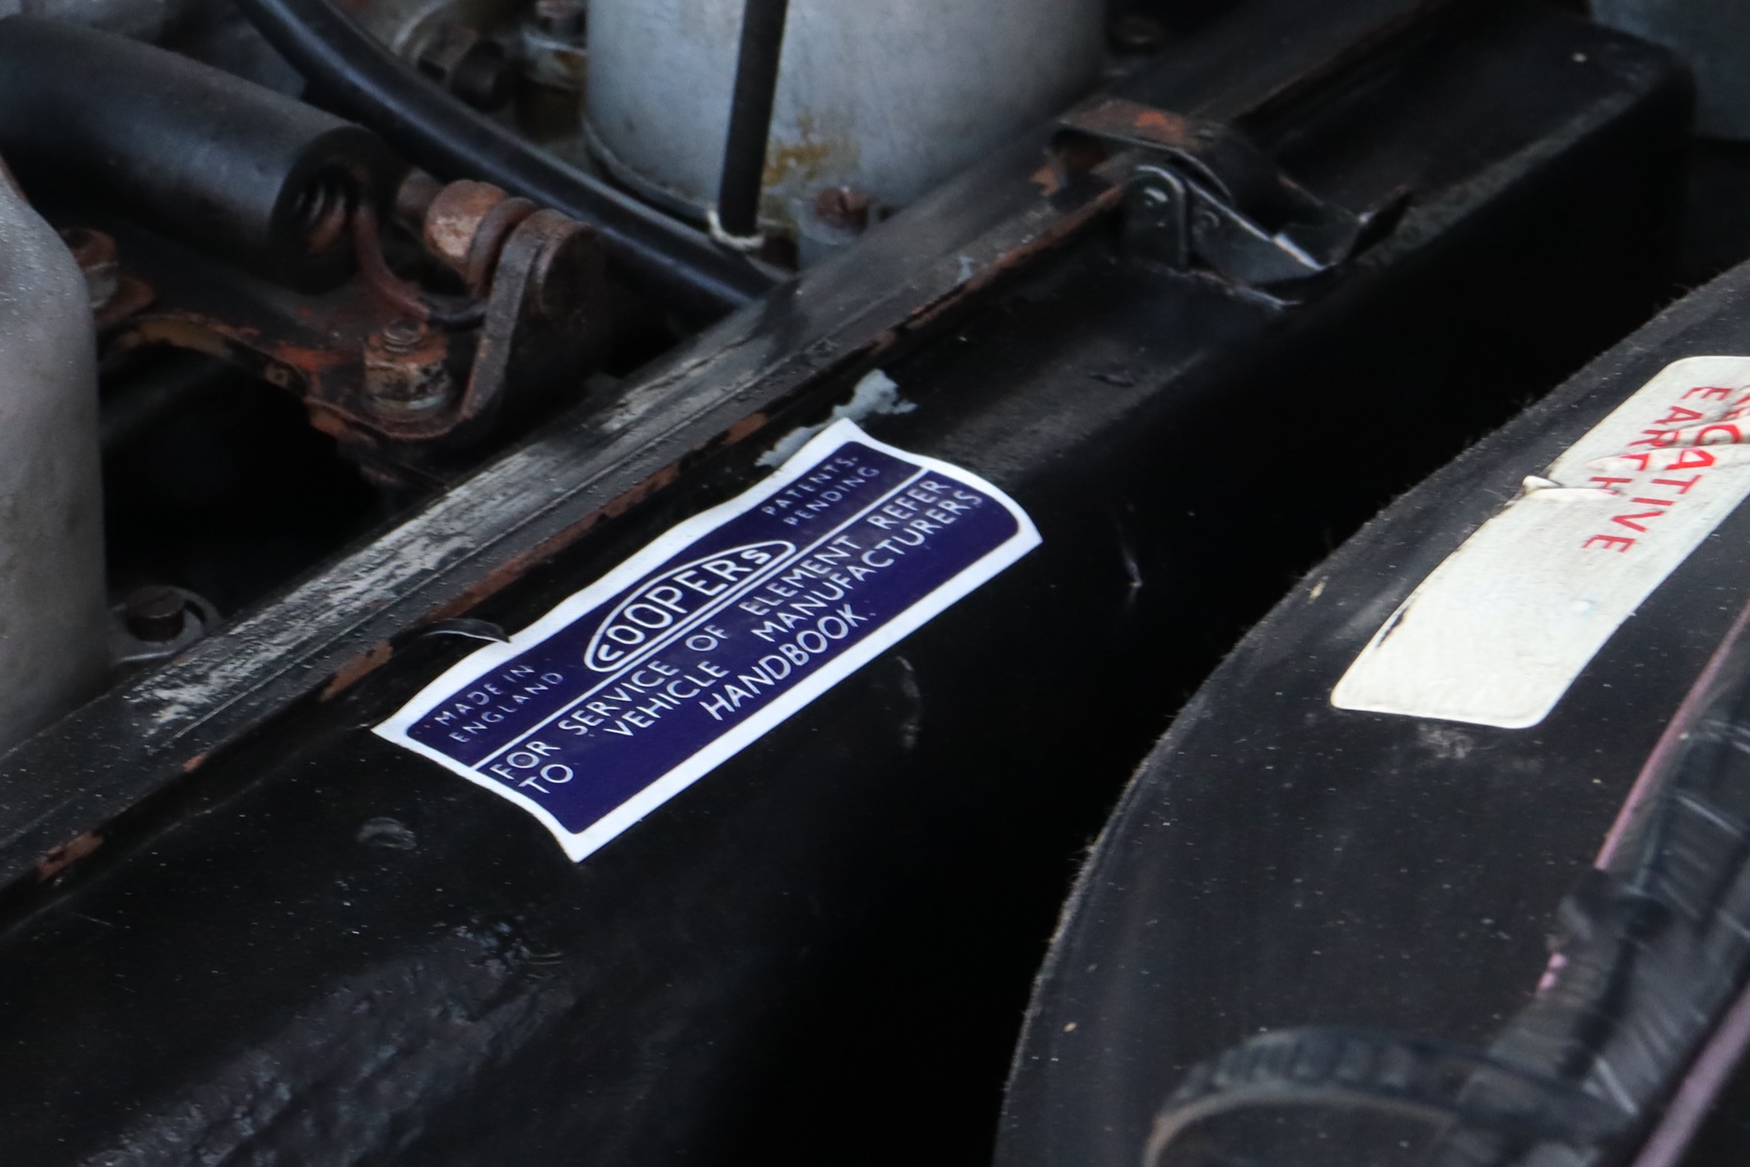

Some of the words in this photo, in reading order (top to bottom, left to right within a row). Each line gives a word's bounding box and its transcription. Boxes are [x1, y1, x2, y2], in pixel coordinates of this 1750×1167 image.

[783, 466, 880, 526] PENDING
[490, 741, 561, 780] FOR
[558, 661, 680, 735] SERVICE
[685, 624, 728, 652] OF
[739, 535, 861, 616] ELEMENT
[866, 480, 952, 530] REFER
[518, 764, 574, 794] TO
[603, 661, 730, 736] VEHICLE
[751, 490, 983, 642] MANUFACTURERS
[597, 549, 772, 661] COOPERS
[434, 683, 503, 725] MADE
[503, 665, 535, 682] IN
[449, 672, 563, 742] ENGLAND
[699, 603, 868, 721] HANDBOOK
